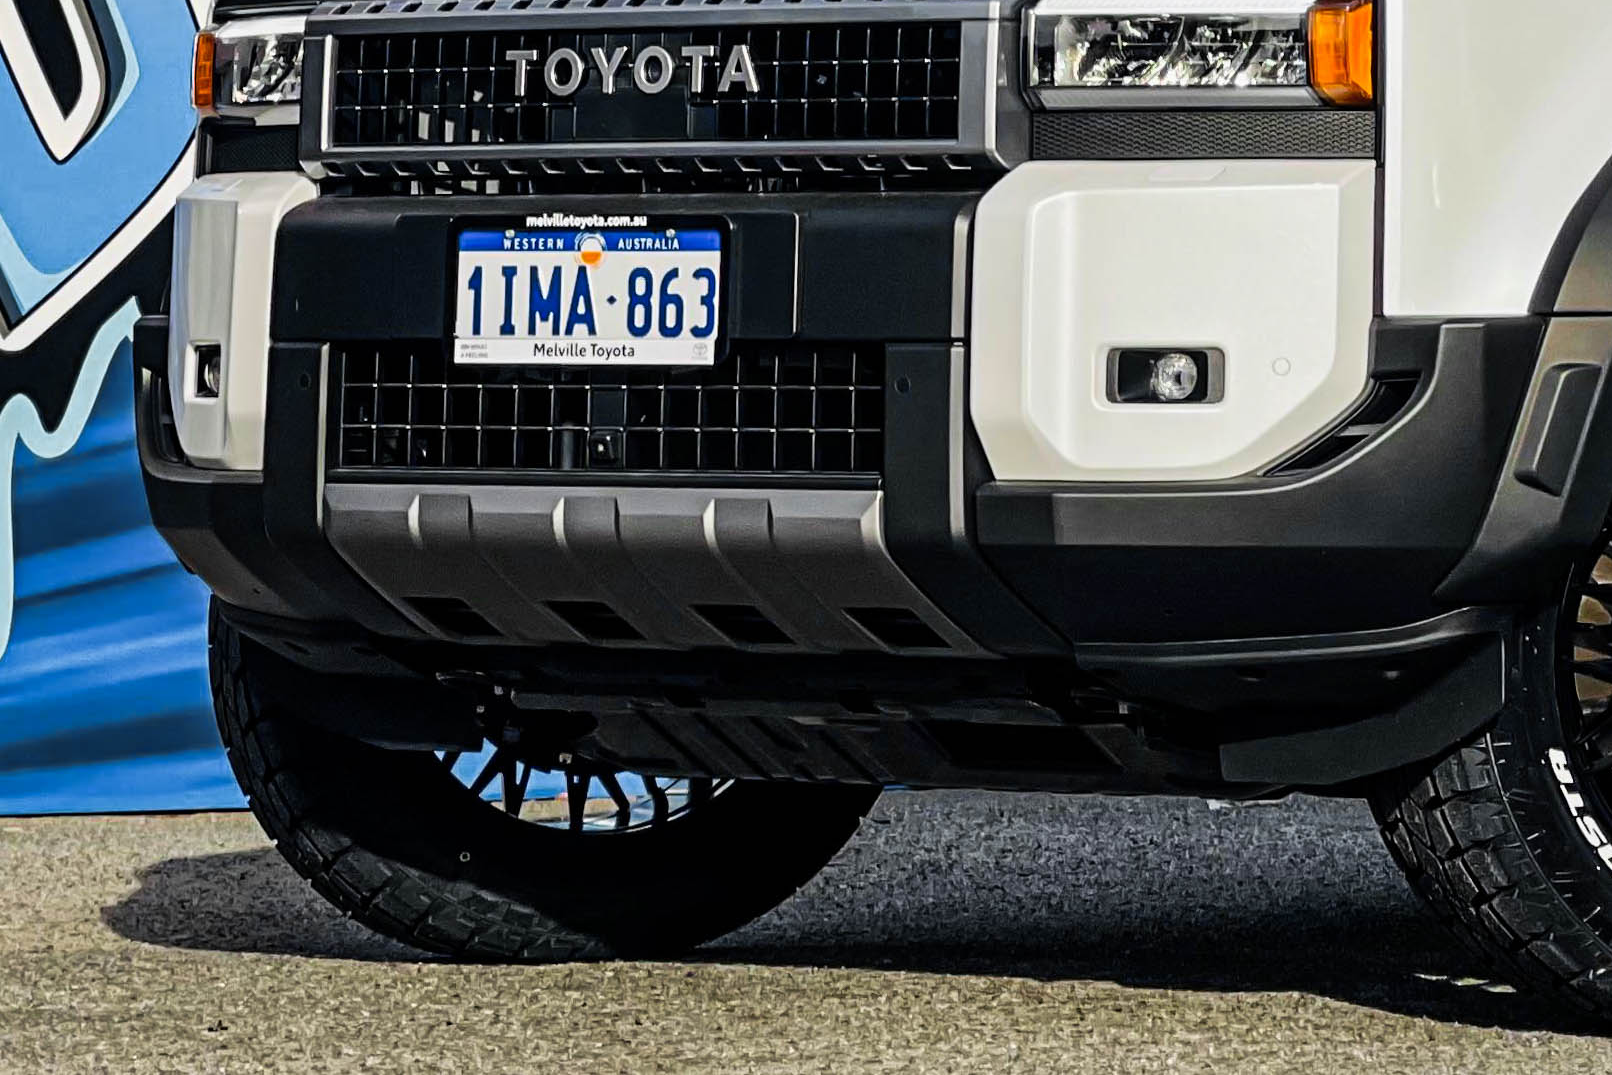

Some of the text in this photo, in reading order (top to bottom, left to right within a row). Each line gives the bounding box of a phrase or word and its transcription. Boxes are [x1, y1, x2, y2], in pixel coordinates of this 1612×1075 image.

[506, 44, 760, 96] TOYOTA
[526, 213, 647, 229] melvilletoyota.com.au
[503, 237, 680, 250] WESTERN AUSTRALIA
[533, 343, 635, 360] Melville Toyota
